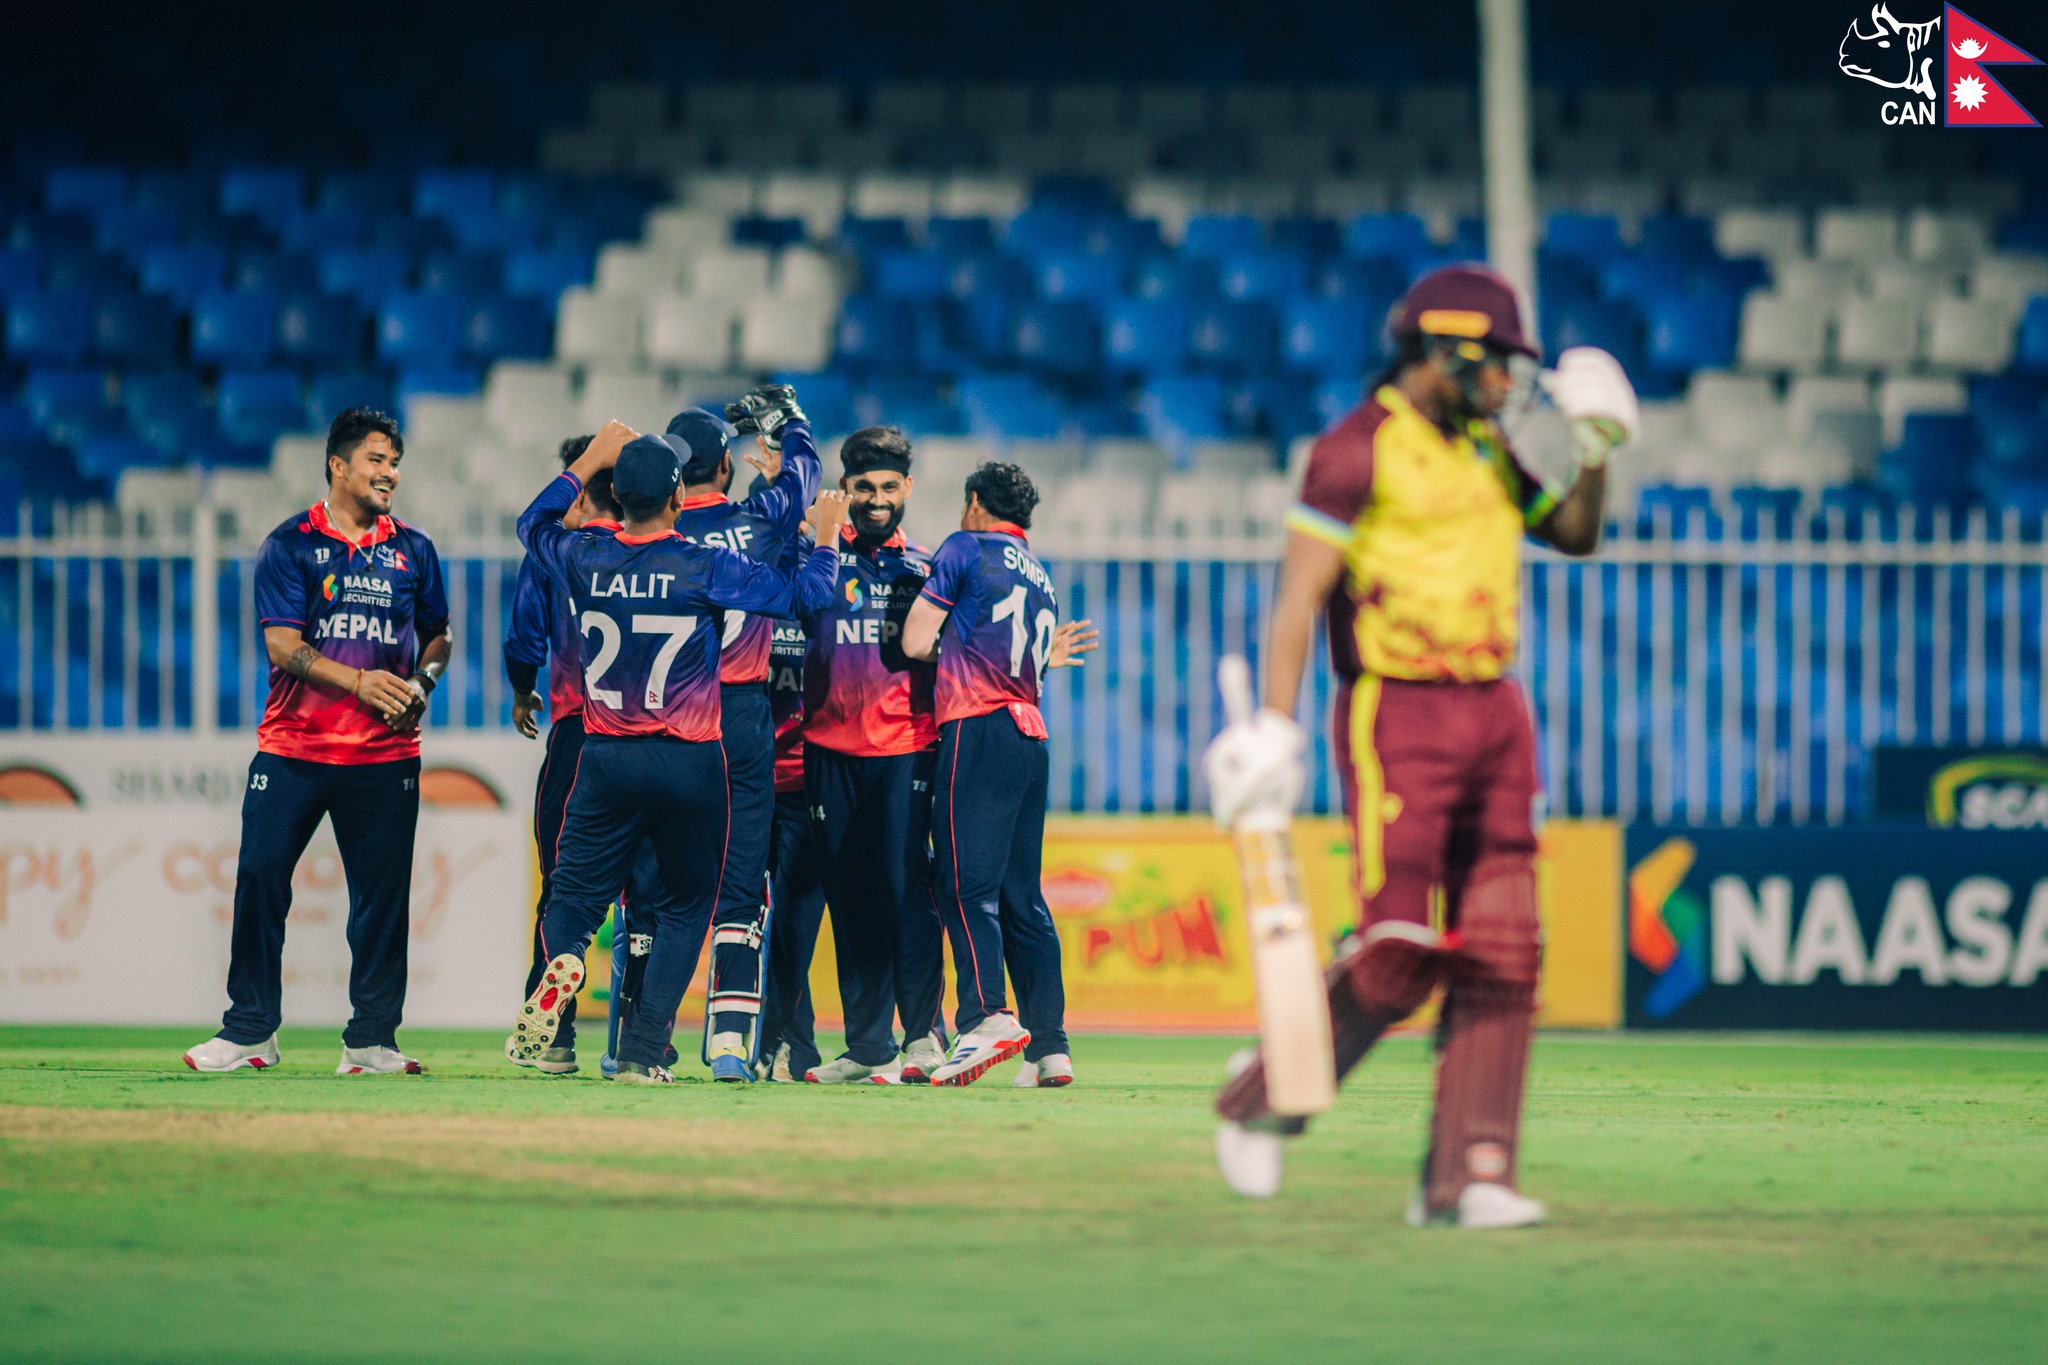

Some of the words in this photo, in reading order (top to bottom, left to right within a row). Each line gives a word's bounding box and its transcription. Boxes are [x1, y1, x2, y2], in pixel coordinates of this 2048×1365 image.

[590, 572, 675, 598] LALIT
[836, 619, 899, 645] NEP
[580, 610, 697, 710] 27
[250, 773, 269, 791] 33
[810, 805, 826, 821] 14
